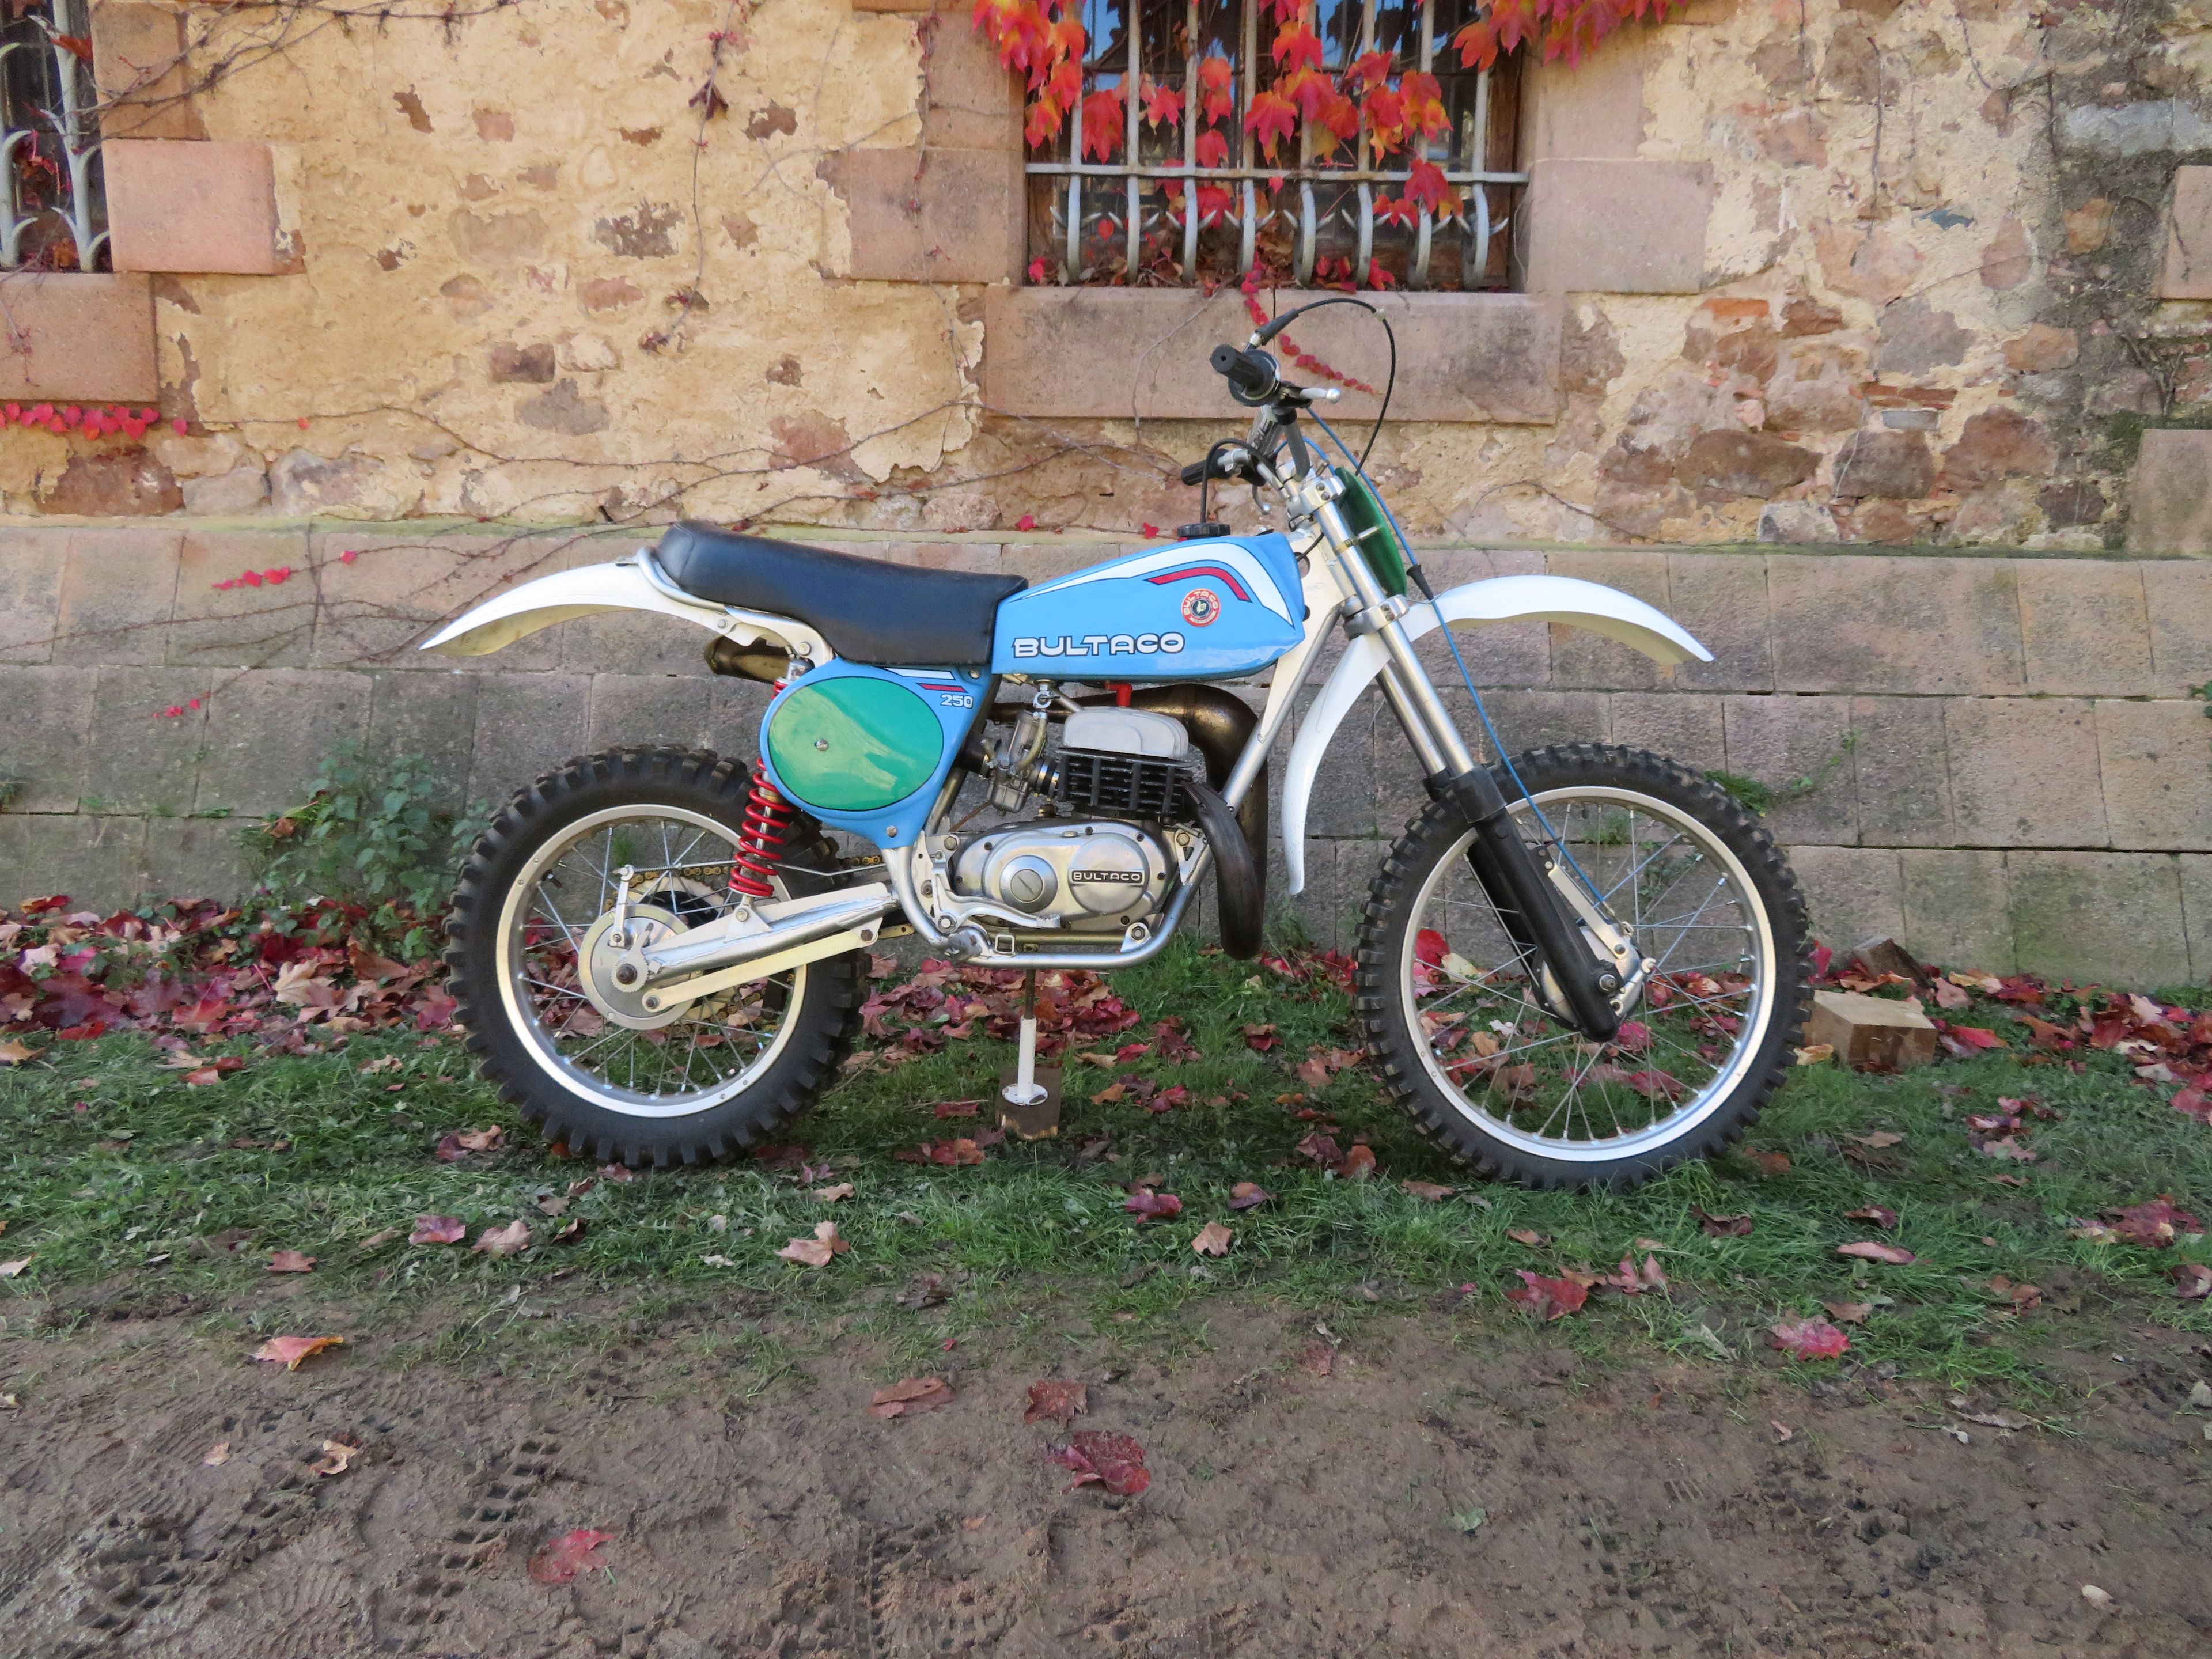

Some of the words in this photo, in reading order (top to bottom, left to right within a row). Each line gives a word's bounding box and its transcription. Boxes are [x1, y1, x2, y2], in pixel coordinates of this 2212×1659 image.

[1183, 590, 1219, 616] BULTACO
[1012, 632, 1185, 658] BULTACO
[940, 694, 974, 709] 250
[1073, 872, 1141, 881] BULTACO
